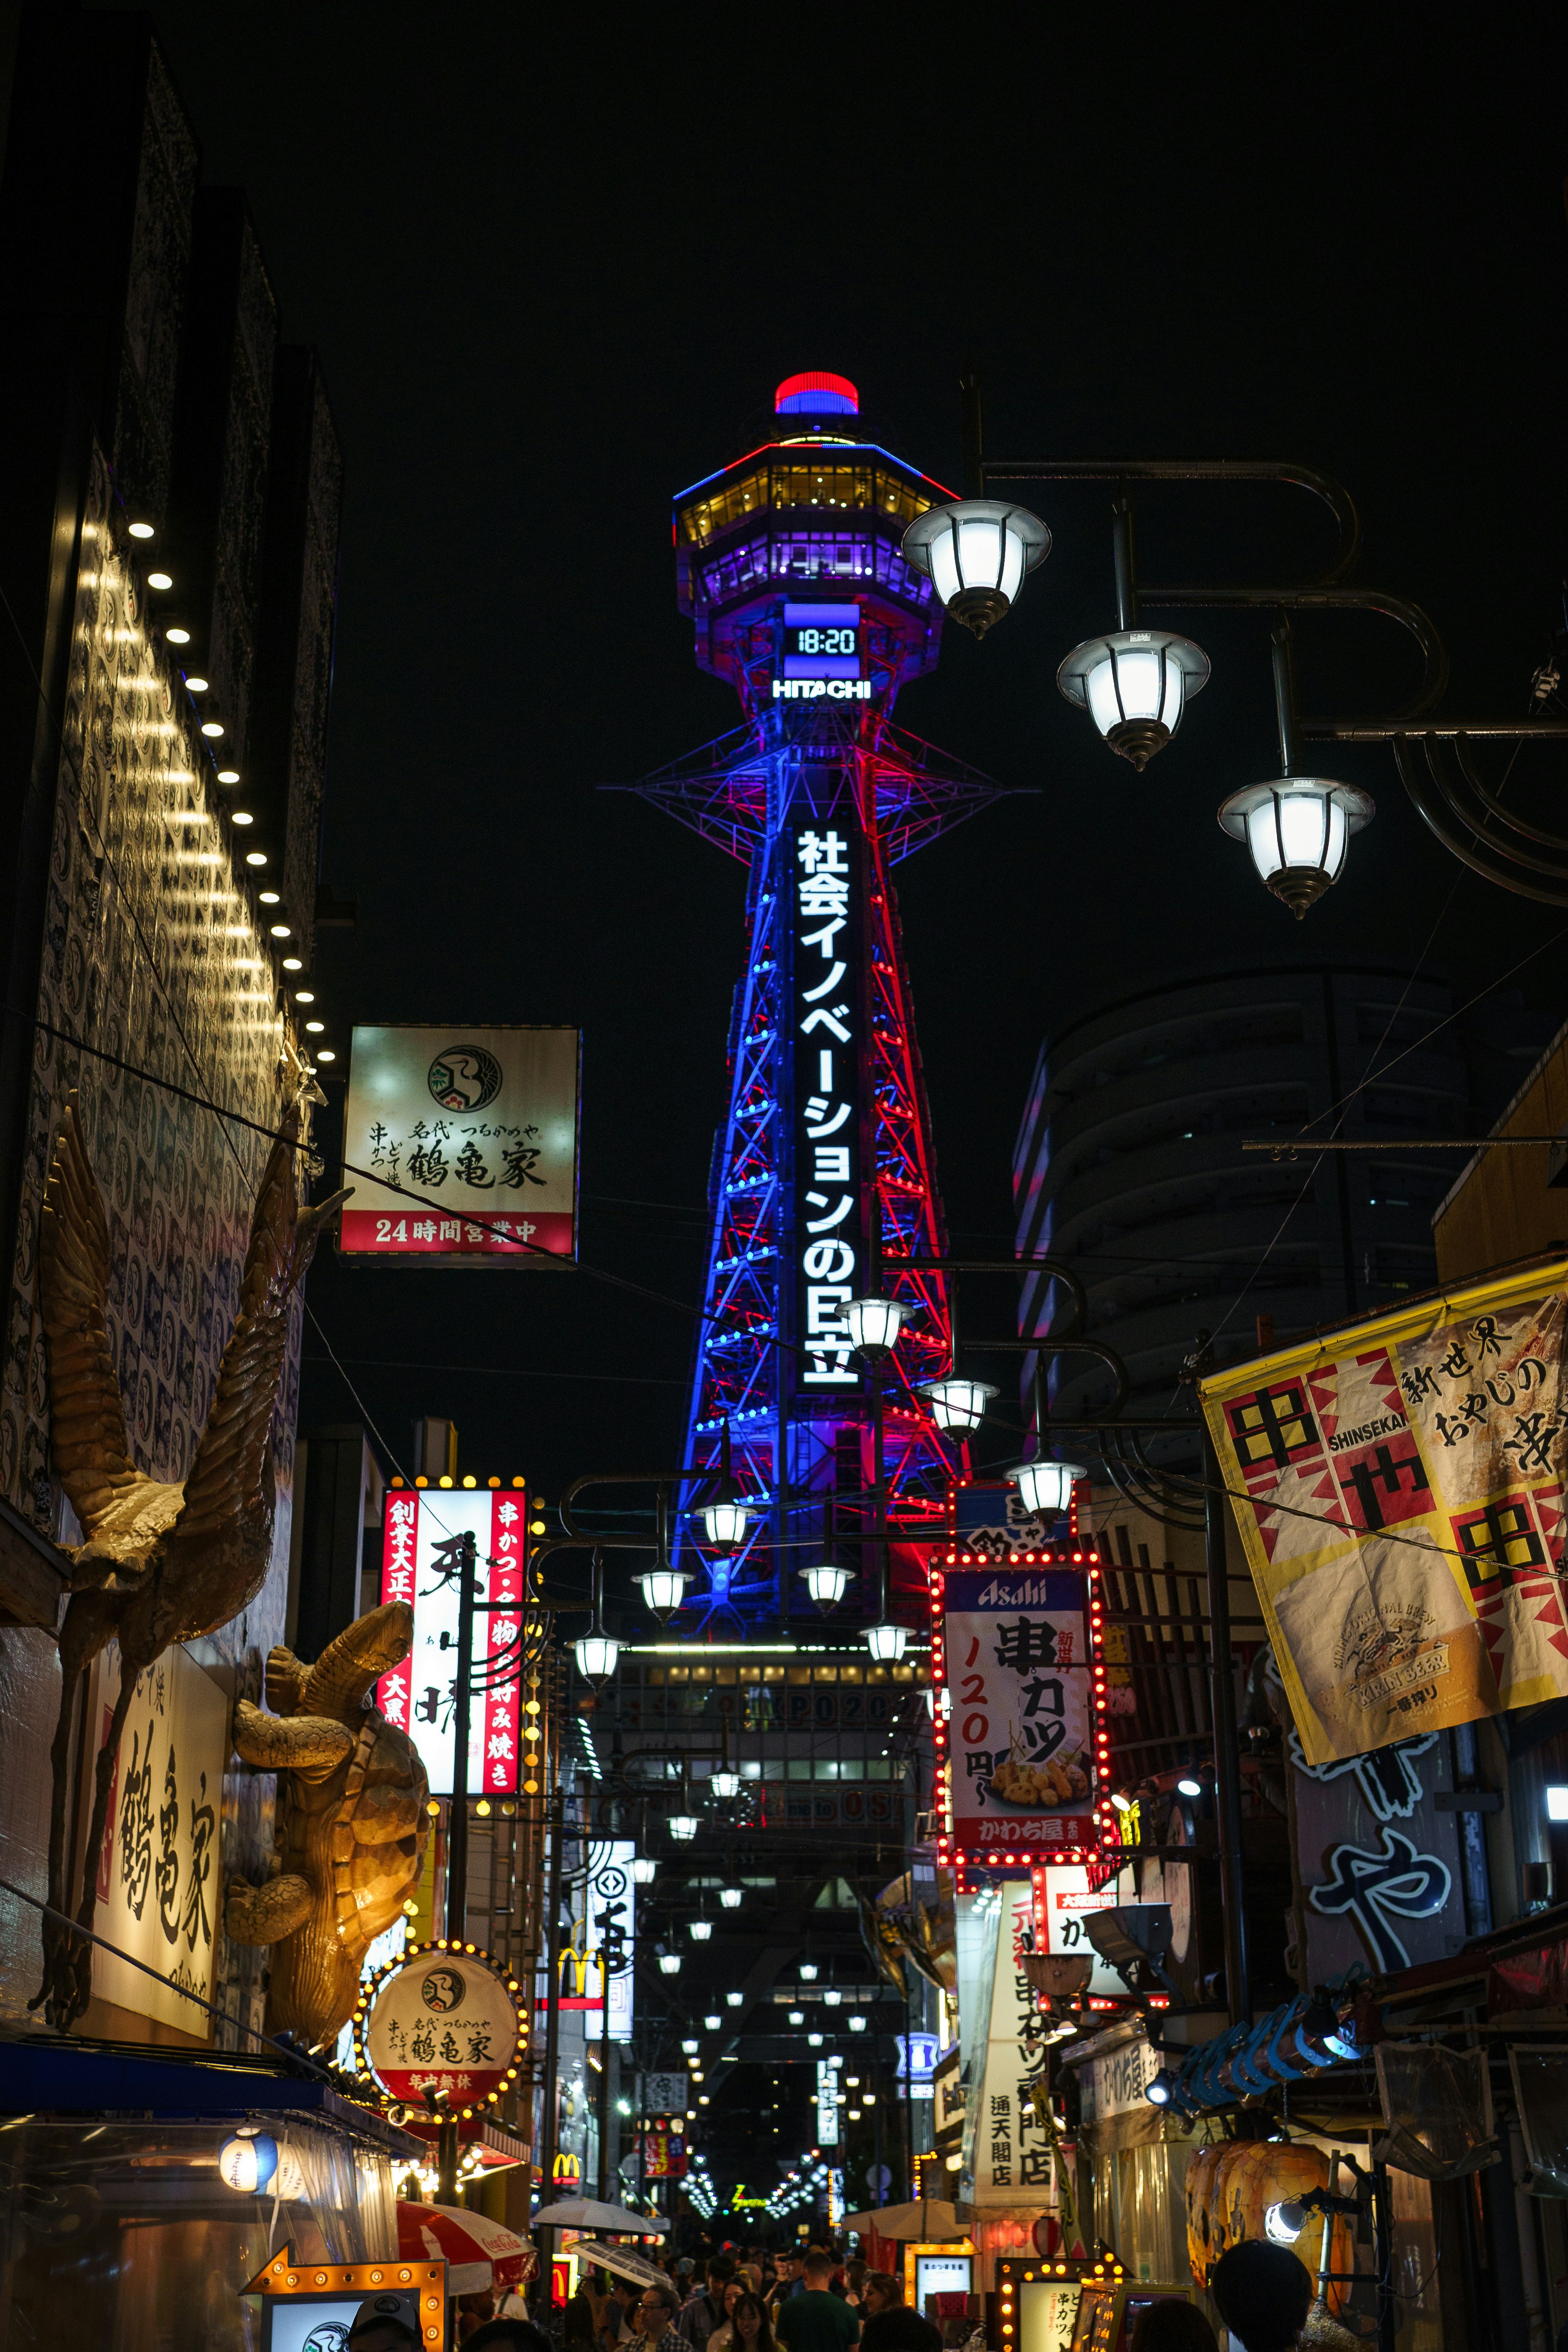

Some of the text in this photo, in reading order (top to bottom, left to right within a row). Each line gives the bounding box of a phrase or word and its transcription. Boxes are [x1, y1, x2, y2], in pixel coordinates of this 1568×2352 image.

[799, 629, 855, 654] 18:20
[773, 680, 871, 699] HITACHI
[798, 830, 858, 1384] 社会イノベーションの日立
[408, 1120, 454, 1140] 名代
[406, 1139, 548, 1190] 鶴亀家
[375, 1219, 536, 1244] 24時間営業中
[1400, 1316, 1513, 1404] 新世界
[1435, 1358, 1546, 1447] おやじの
[1327, 1411, 1408, 1452] SHINSEKAI
[1230, 1386, 1430, 1532] 串 や
[978, 1579, 1046, 1607] Asahi
[993, 1615, 1066, 1764] 串カツ
[1360, 1671, 1403, 1706] KIRIN
[1405, 1653, 1446, 1683] BEER
[1386, 1684, 1438, 1715] 一番搾り
[119, 1719, 215, 1953] 鶴亀家
[978, 1818, 1064, 1841] かわち屋
[410, 2030, 495, 2064] 鶴亀家
[408, 2073, 472, 2090] 年中無休
[991, 2095, 1011, 2187] 通天閣店
